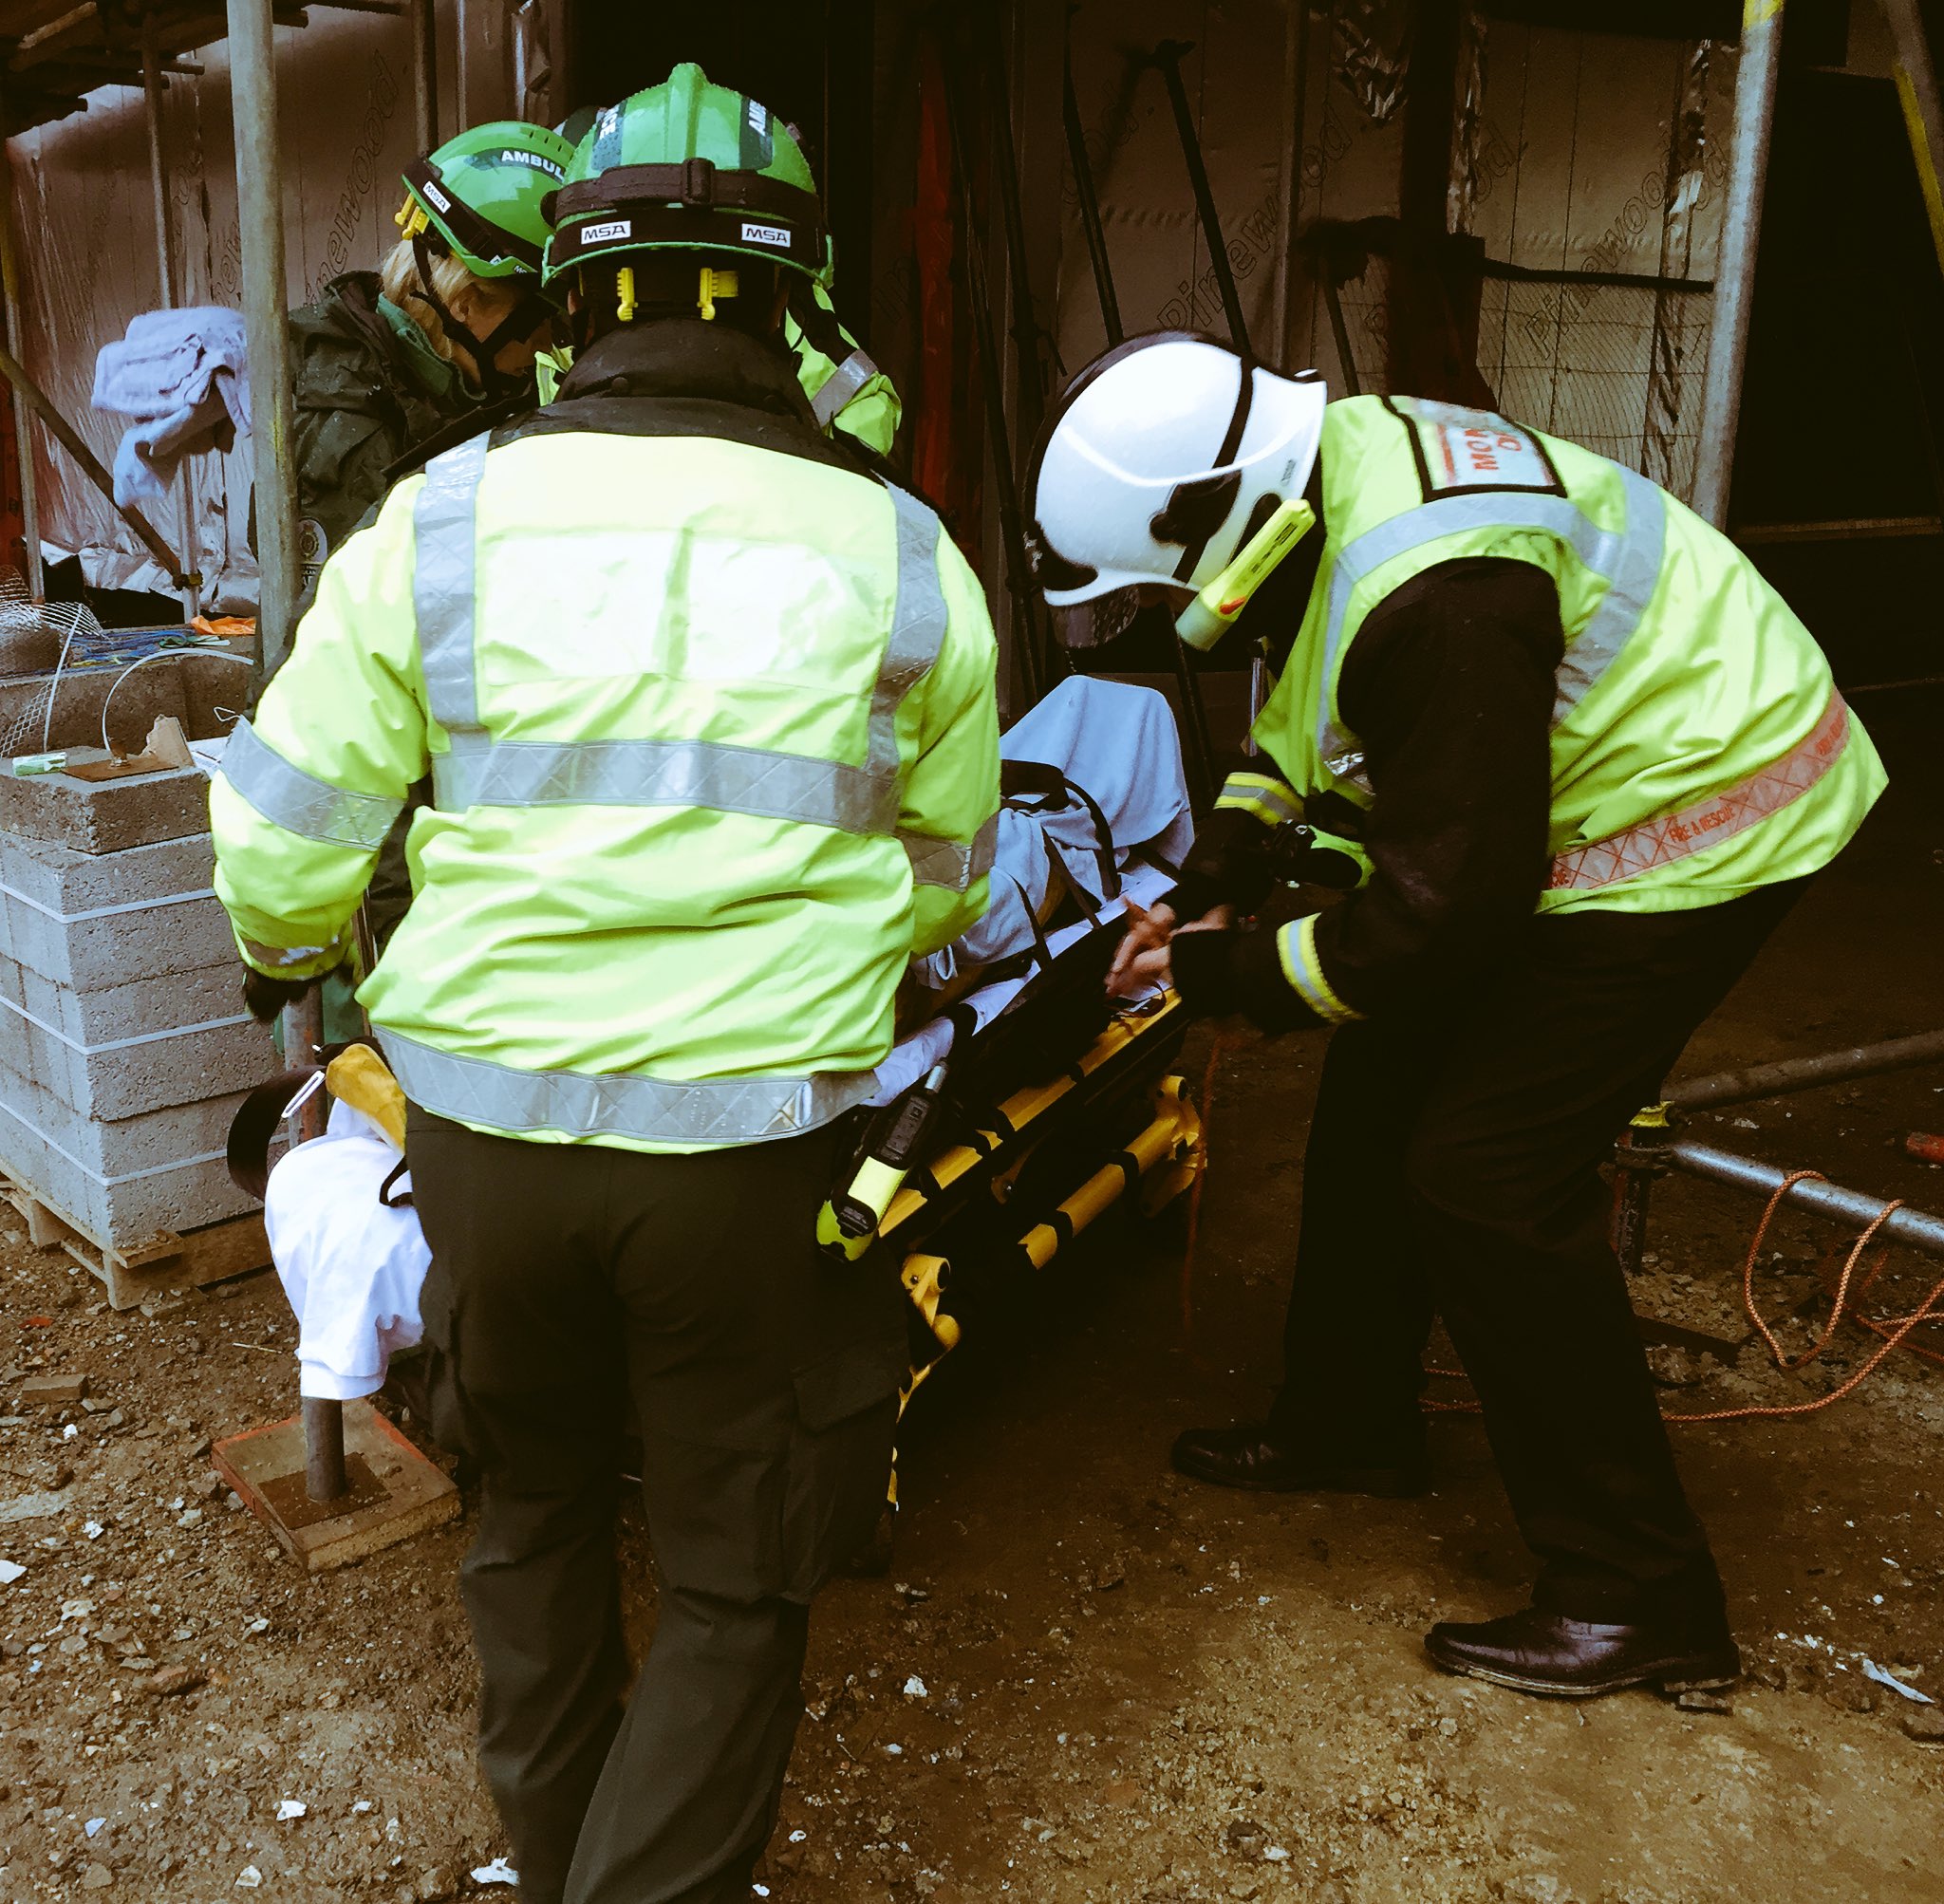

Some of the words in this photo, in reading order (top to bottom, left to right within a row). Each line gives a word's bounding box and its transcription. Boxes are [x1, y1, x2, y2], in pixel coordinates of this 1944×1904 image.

[303, 48, 399, 306] inewood
[501, 149, 564, 181] AMBUL
[425, 184, 448, 210] MSA
[1156, 98, 1353, 329] Pinewod
[584, 224, 626, 241] MSA
[745, 228, 788, 244] MSA
